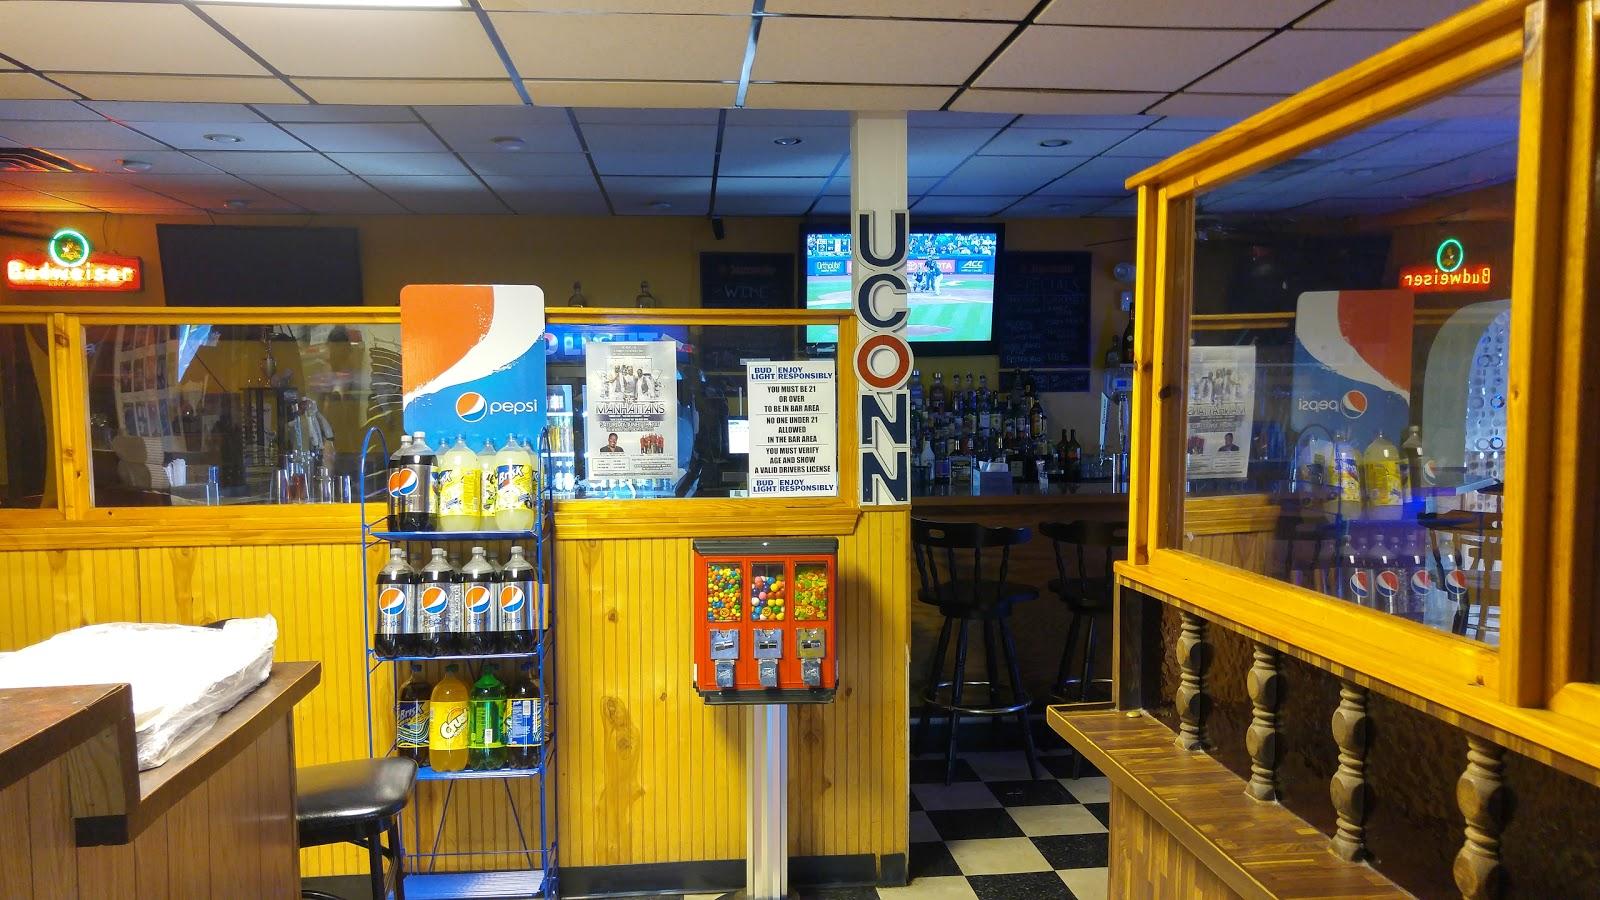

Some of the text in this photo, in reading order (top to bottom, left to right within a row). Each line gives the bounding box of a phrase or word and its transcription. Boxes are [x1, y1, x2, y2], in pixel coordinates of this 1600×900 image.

[7, 259, 135, 282] Budweiser
[854, 210, 911, 505] UCONN
[490, 399, 538, 414] pepsi
[596, 404, 665, 414] MANHATTANS
